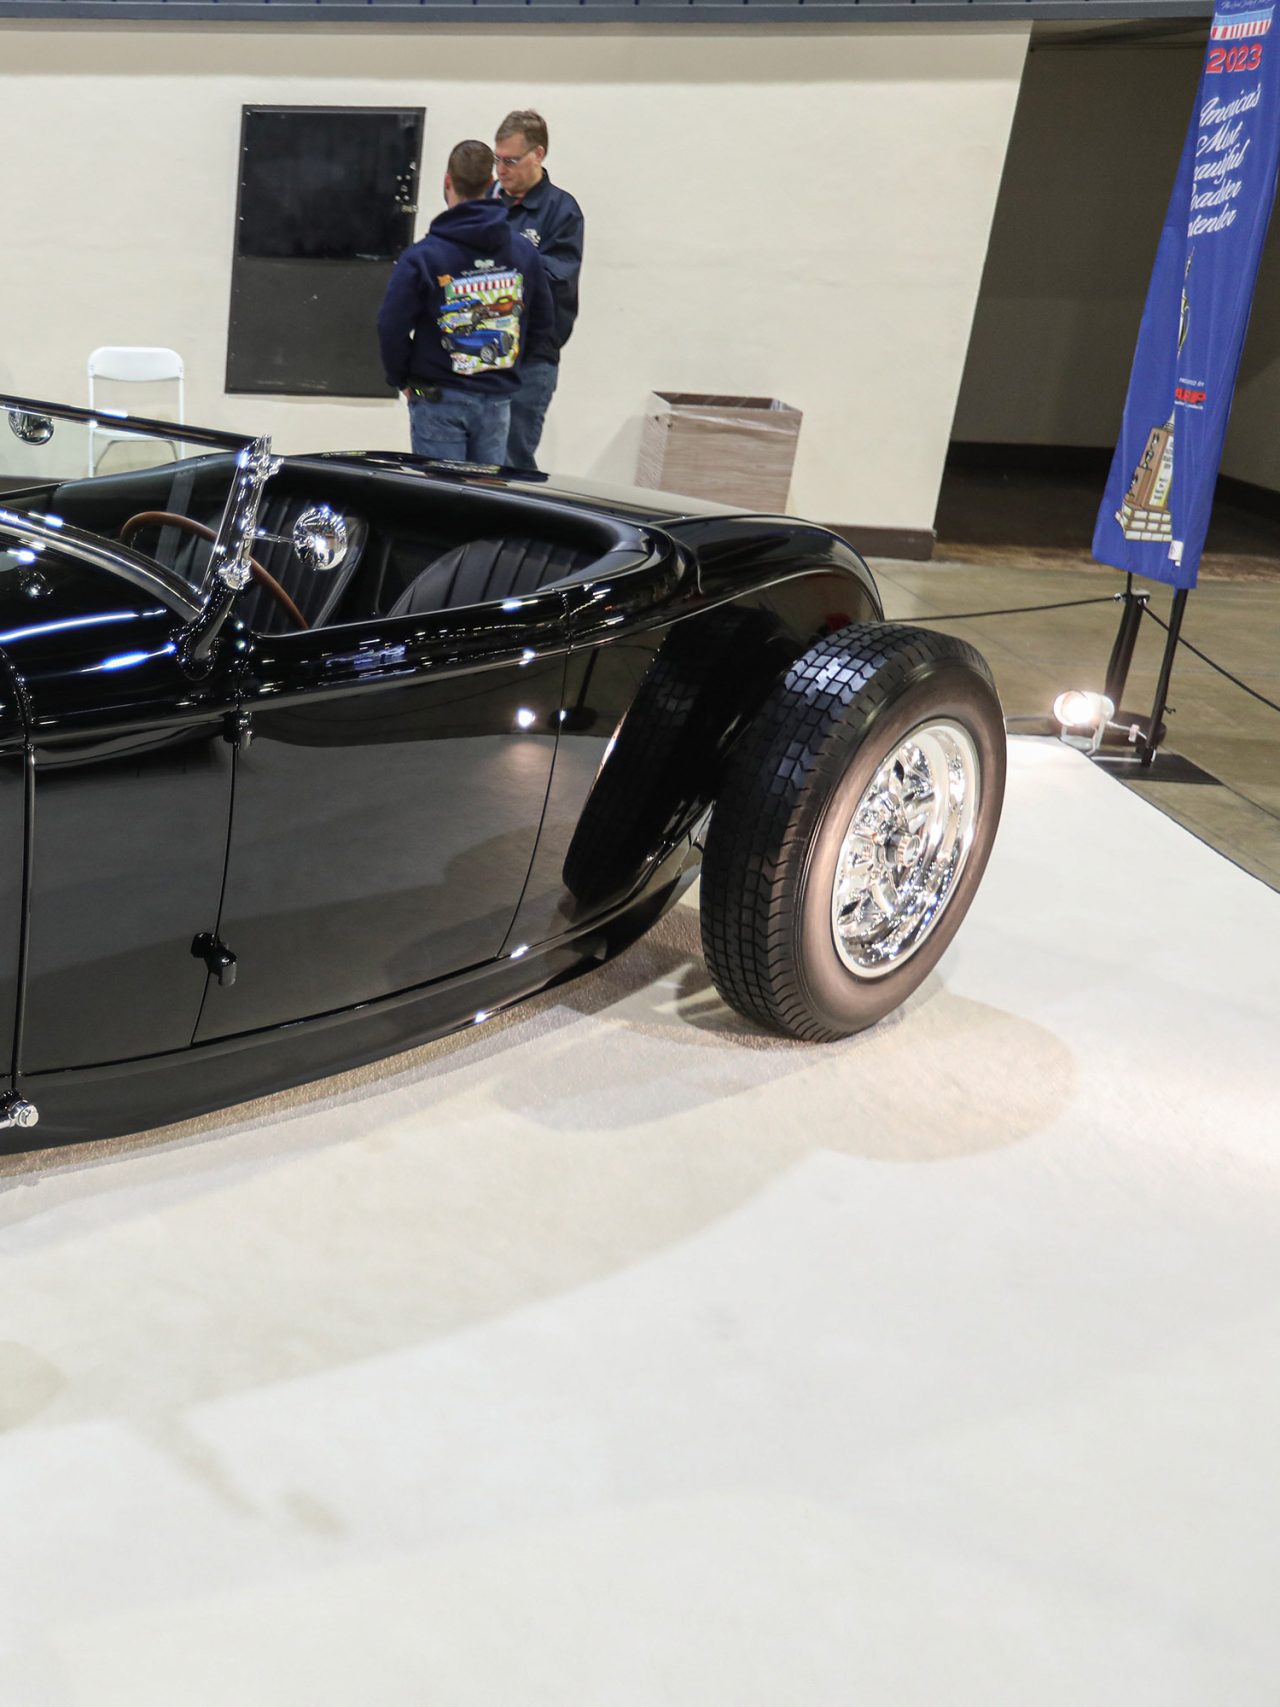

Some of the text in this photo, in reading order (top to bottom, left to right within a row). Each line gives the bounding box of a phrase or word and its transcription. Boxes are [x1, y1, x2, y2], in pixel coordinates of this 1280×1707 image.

[1205, 43, 1263, 74] 2023
[1195, 119, 1244, 158] Most
[1194, 139, 1251, 185] autiful
[1190, 178, 1243, 212] oadster
